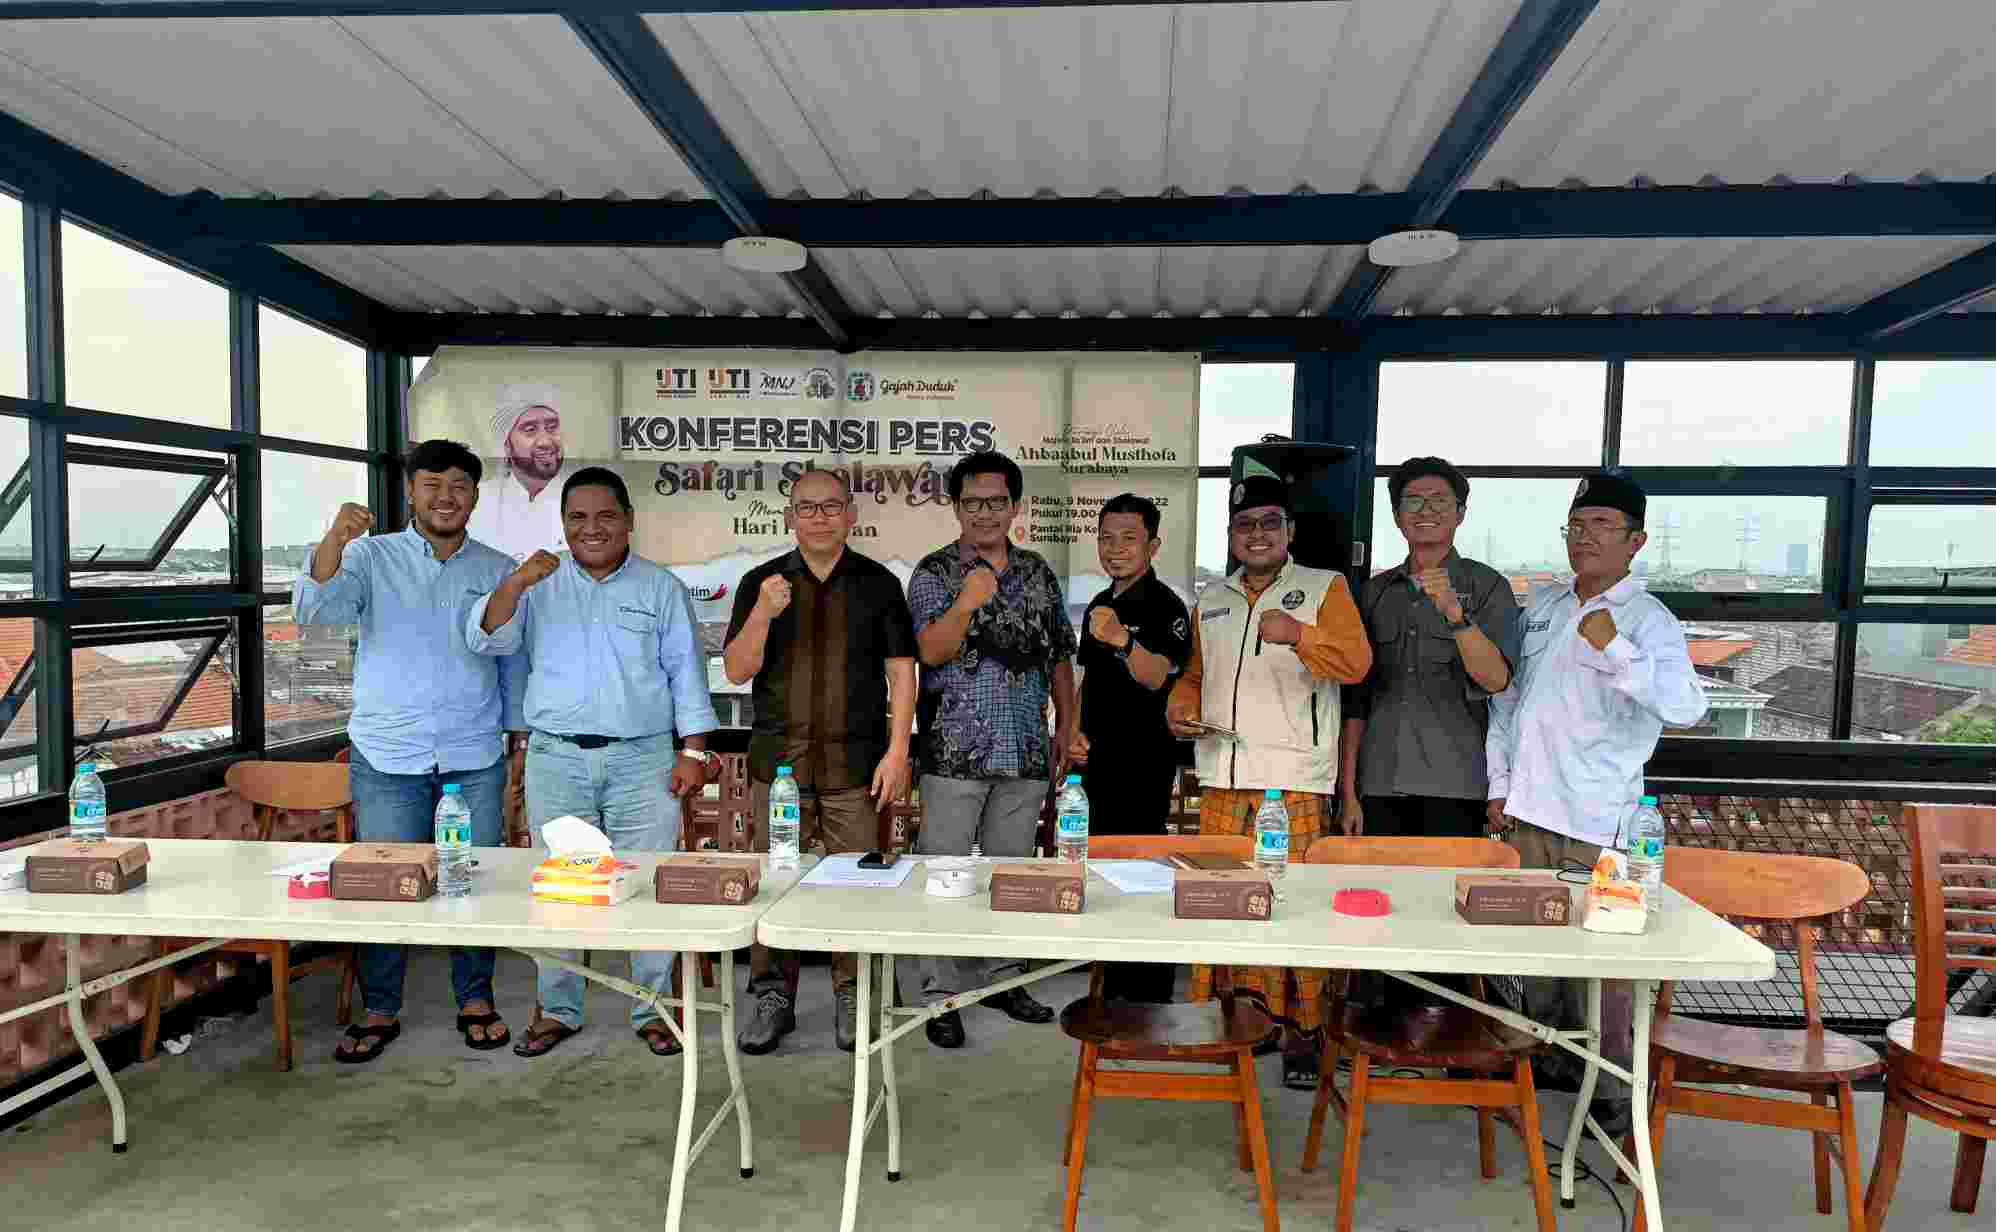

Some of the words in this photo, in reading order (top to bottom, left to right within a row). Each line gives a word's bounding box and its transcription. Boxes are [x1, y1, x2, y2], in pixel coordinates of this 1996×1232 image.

[881, 380, 915, 395] Gajah
[916, 380, 955, 393] Duduk
[620, 417, 878, 452] KONFERENSI
[889, 420, 994, 454] PERS
[1016, 446, 1097, 461] Ahbaabul
[1101, 446, 1176, 461] Musthofa
[1061, 462, 1129, 479] Surabaya
[655, 460, 765, 500] Safari
[1032, 496, 1064, 507] Rabu,
[1066, 496, 1073, 505] 9
[1032, 508, 1063, 518] Pukul
[734, 517, 778, 536] Hari
[1030, 525, 1063, 534] Pantai
[1030, 534, 1078, 545] Surabaya
